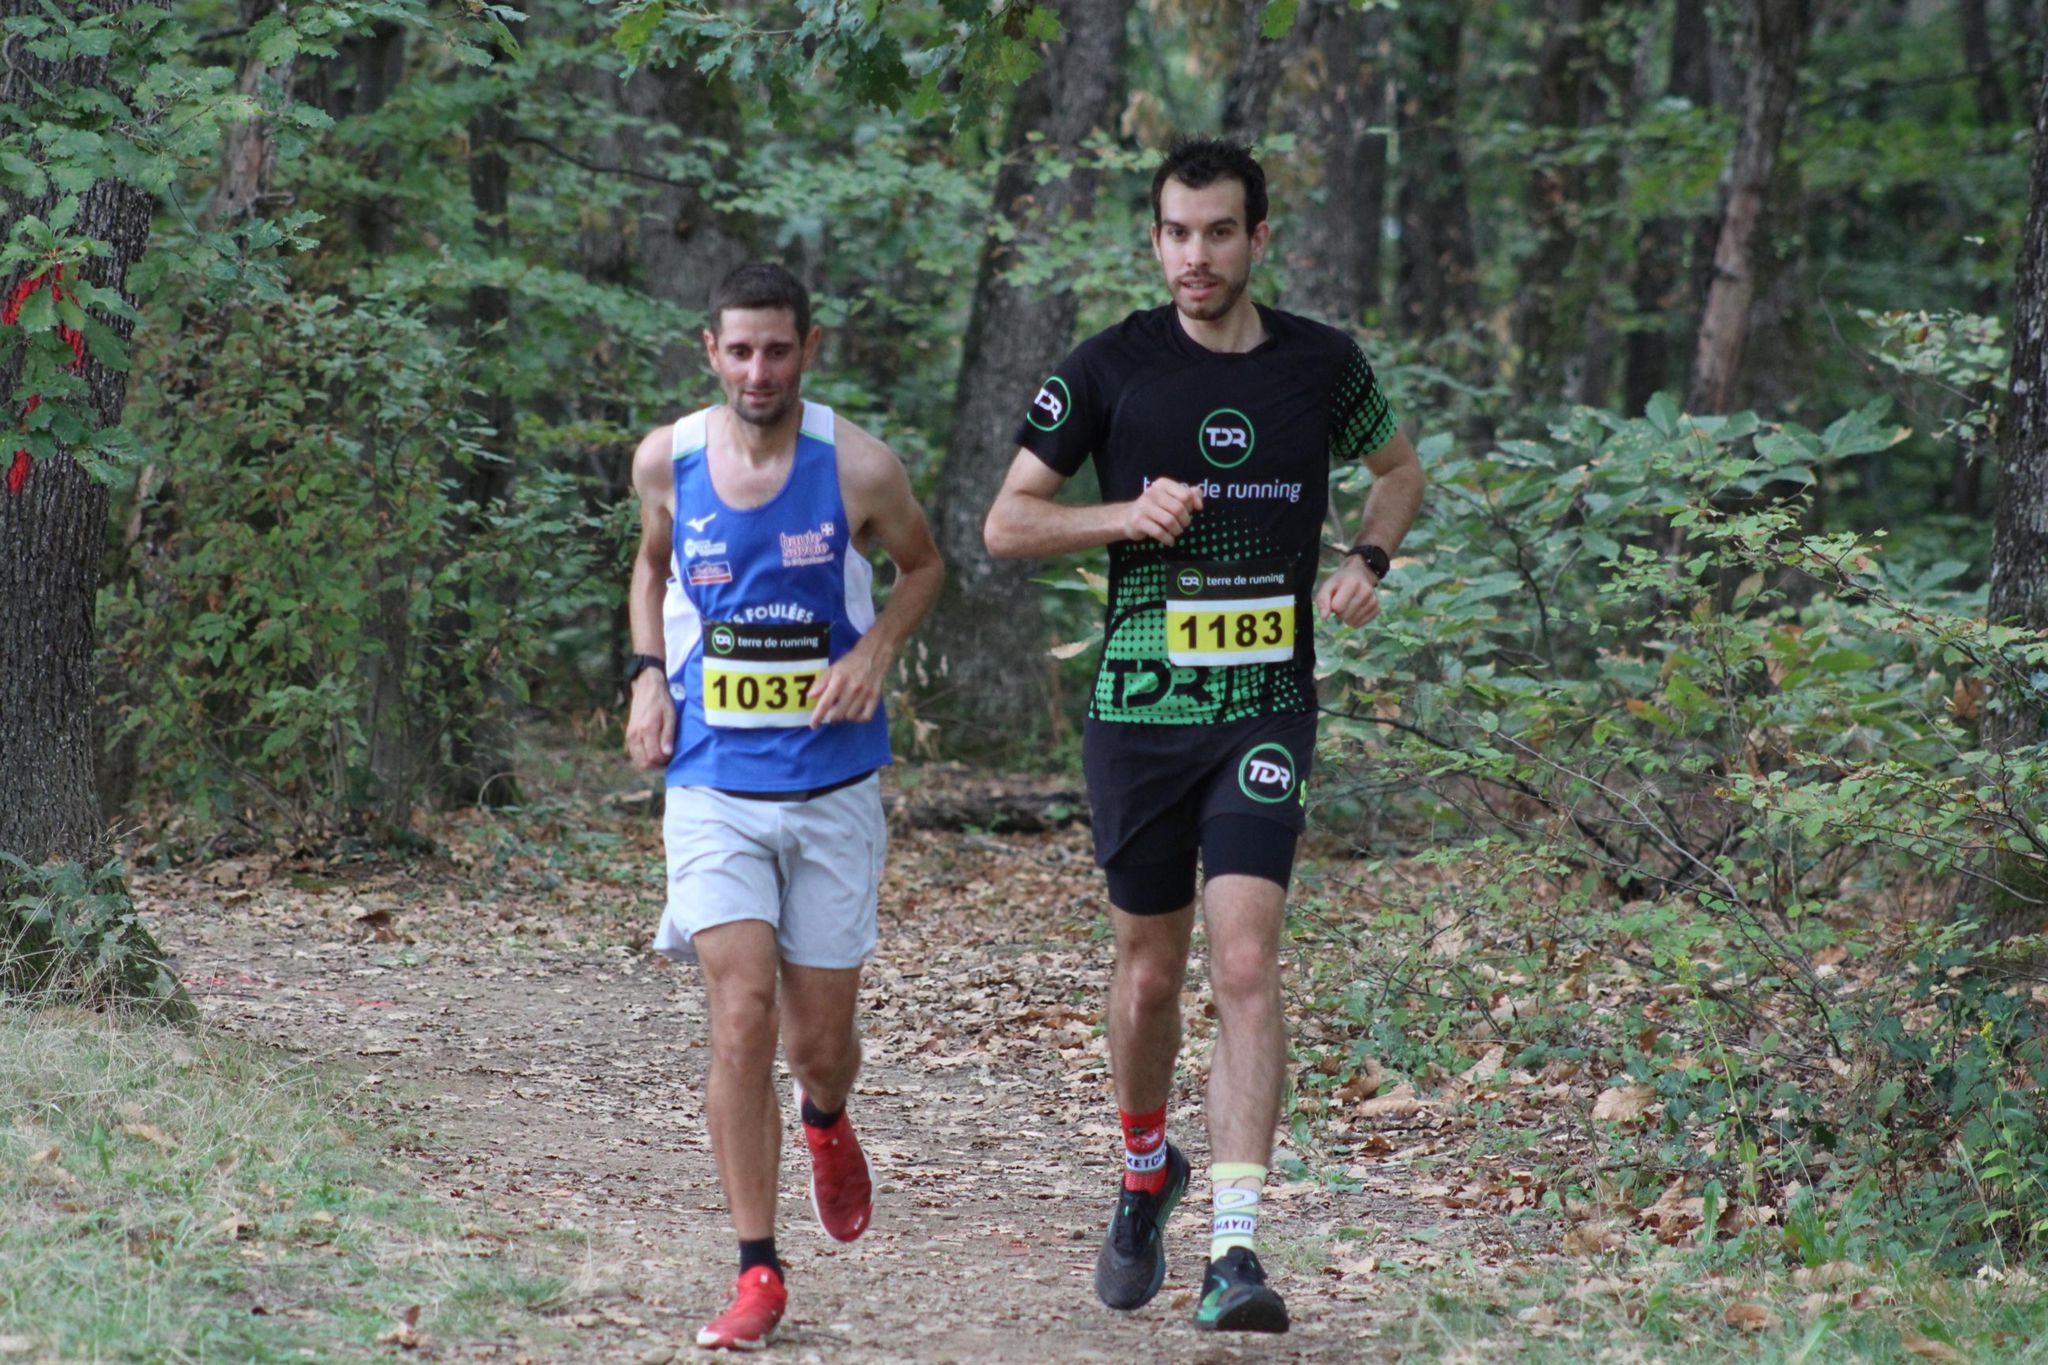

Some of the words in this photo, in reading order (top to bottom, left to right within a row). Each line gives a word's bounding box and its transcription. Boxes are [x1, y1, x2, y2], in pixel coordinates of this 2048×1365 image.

[1206, 427, 1248, 449] TDR
[1199, 478, 1221, 498] de
[1227, 478, 1302, 503] running
[1206, 576, 1232, 586] terre
[1233, 575, 1247, 585] de
[1249, 573, 1285, 585] running
[745, 602, 815, 624] FOULÉES
[1180, 611, 1283, 649] 1183
[737, 636, 762, 648] terre
[764, 636, 778, 648] de
[780, 636, 819, 648] running
[712, 674, 816, 710] 1037
[1249, 759, 1291, 790] TDR
